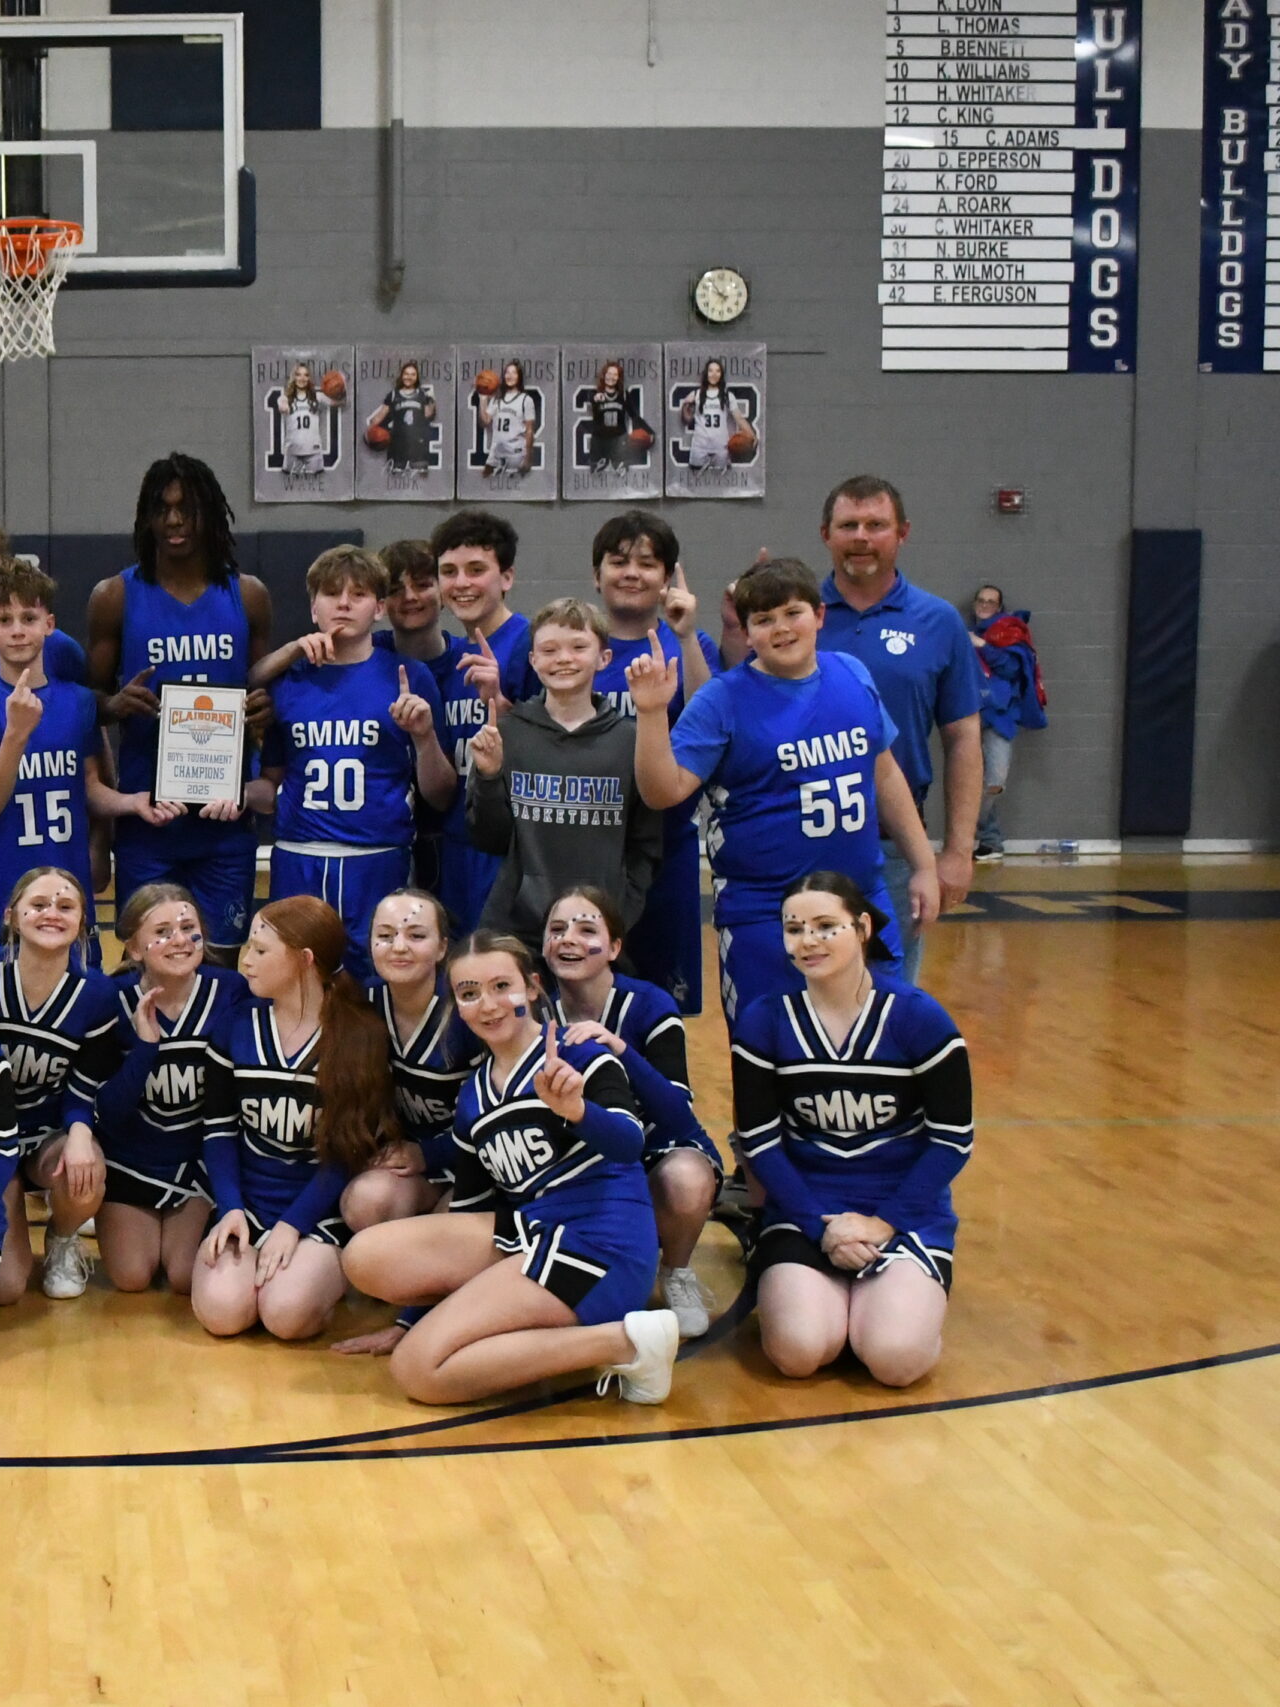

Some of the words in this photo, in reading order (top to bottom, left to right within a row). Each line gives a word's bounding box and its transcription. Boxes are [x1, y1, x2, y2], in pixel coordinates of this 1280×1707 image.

[894, 17, 901, 32] 3
[938, 17, 950, 33] L.
[955, 17, 1020, 34] THOMAS
[896, 40, 904, 56] 5
[893, 62, 909, 79] 10
[937, 63, 951, 79] K.
[956, 63, 1030, 80] WILLIAMS
[893, 85, 907, 101] 11
[937, 85, 951, 102] H.
[956, 85, 1037, 102] WHITAKER
[893, 107, 909, 124] 12
[937, 107, 951, 124] C.
[957, 107, 994, 124] KING
[942, 130, 958, 146] 15
[986, 130, 1000, 146] C.
[1004, 130, 1059, 147] ADAMS
[894, 152, 910, 169] 20
[938, 152, 952, 168] D.
[958, 152, 1041, 168] EPPERSON
[936, 174, 949, 190] K.
[955, 174, 997, 191] FORD
[937, 197, 951, 213] A.
[957, 196, 1012, 213] ROARK
[935, 219, 948, 235] C.
[953, 219, 1033, 235] WHITAKER
[1218, 109, 1248, 347] BULLDOGS
[936, 241, 950, 257] N.
[956, 241, 1009, 258] BURKE
[890, 264, 906, 280] 34
[934, 264, 948, 280] R.
[953, 264, 1025, 280] WILMOTH
[889, 286, 905, 302] 42
[933, 286, 947, 302] E.
[952, 286, 1036, 302] FERGUSON
[296, 415, 310, 430] 10
[497, 418, 510, 432] 12
[704, 415, 720, 428] 33
[147, 633, 234, 664] SMMS
[172, 710, 233, 729] CLAIBORNE
[291, 719, 379, 748] SMMS
[777, 726, 870, 772] SMMS
[168, 752, 184, 762] BOYS
[187, 753, 233, 765] TOURNAMENT
[173, 765, 225, 779] CHAMPIONS
[187, 785, 210, 795] 2025
[303, 758, 365, 811] 20
[511, 771, 561, 802] BLUE
[565, 775, 623, 805] DEVIL
[799, 771, 866, 838] 55
[15, 790, 72, 846] 15
[512, 802, 623, 825] BASKETBALL
[794, 1090, 897, 1131] SMMS
[241, 1097, 322, 1142] SMM
[478, 1127, 554, 1184] SMMS
